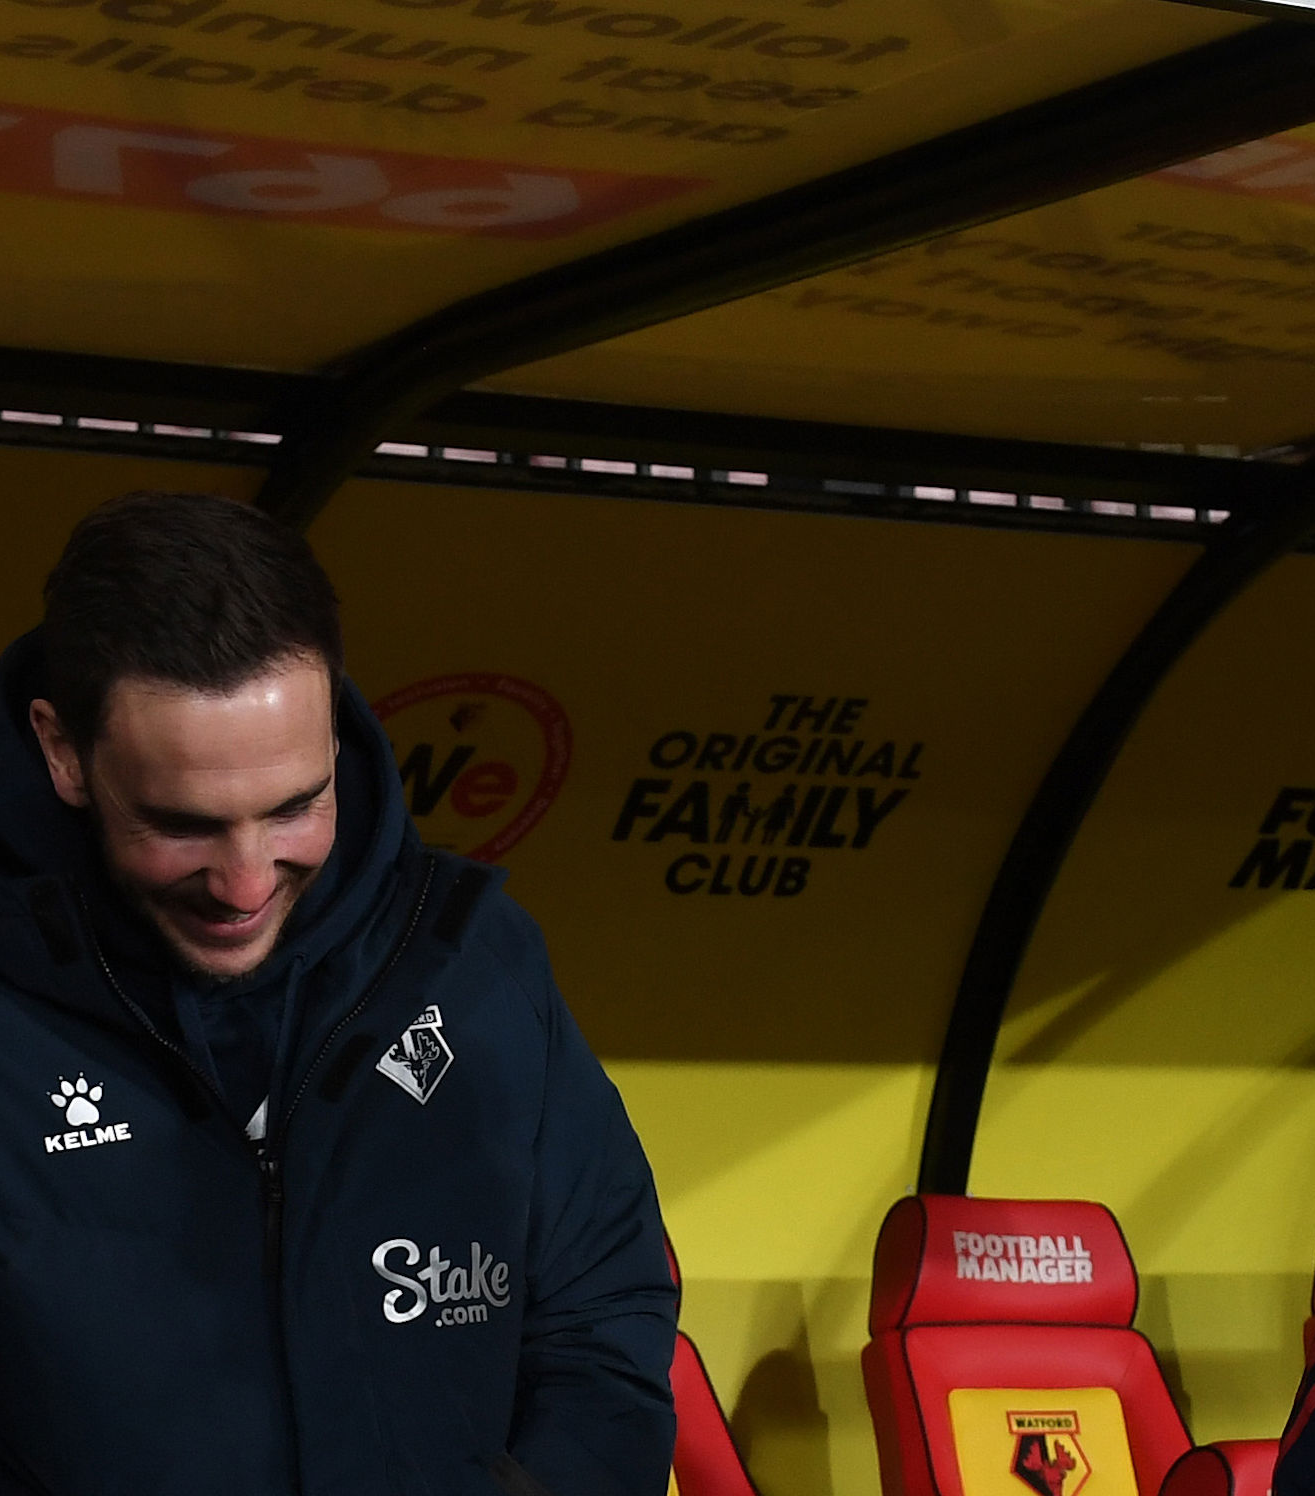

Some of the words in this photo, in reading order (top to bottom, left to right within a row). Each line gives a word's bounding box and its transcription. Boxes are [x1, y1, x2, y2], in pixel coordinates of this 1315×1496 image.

[765, 694, 869, 736] THE
[648, 730, 926, 781] ORIGINAL
[663, 851, 813, 899] CLUB
[43, 1122, 132, 1153] KELME
[953, 1231, 1090, 1258] FOOTBALL
[372, 1238, 511, 1323] Stake
[957, 1255, 1093, 1284] MANAGER
[434, 1303, 489, 1327] .com
[1015, 1417, 1073, 1429] WATFORD
